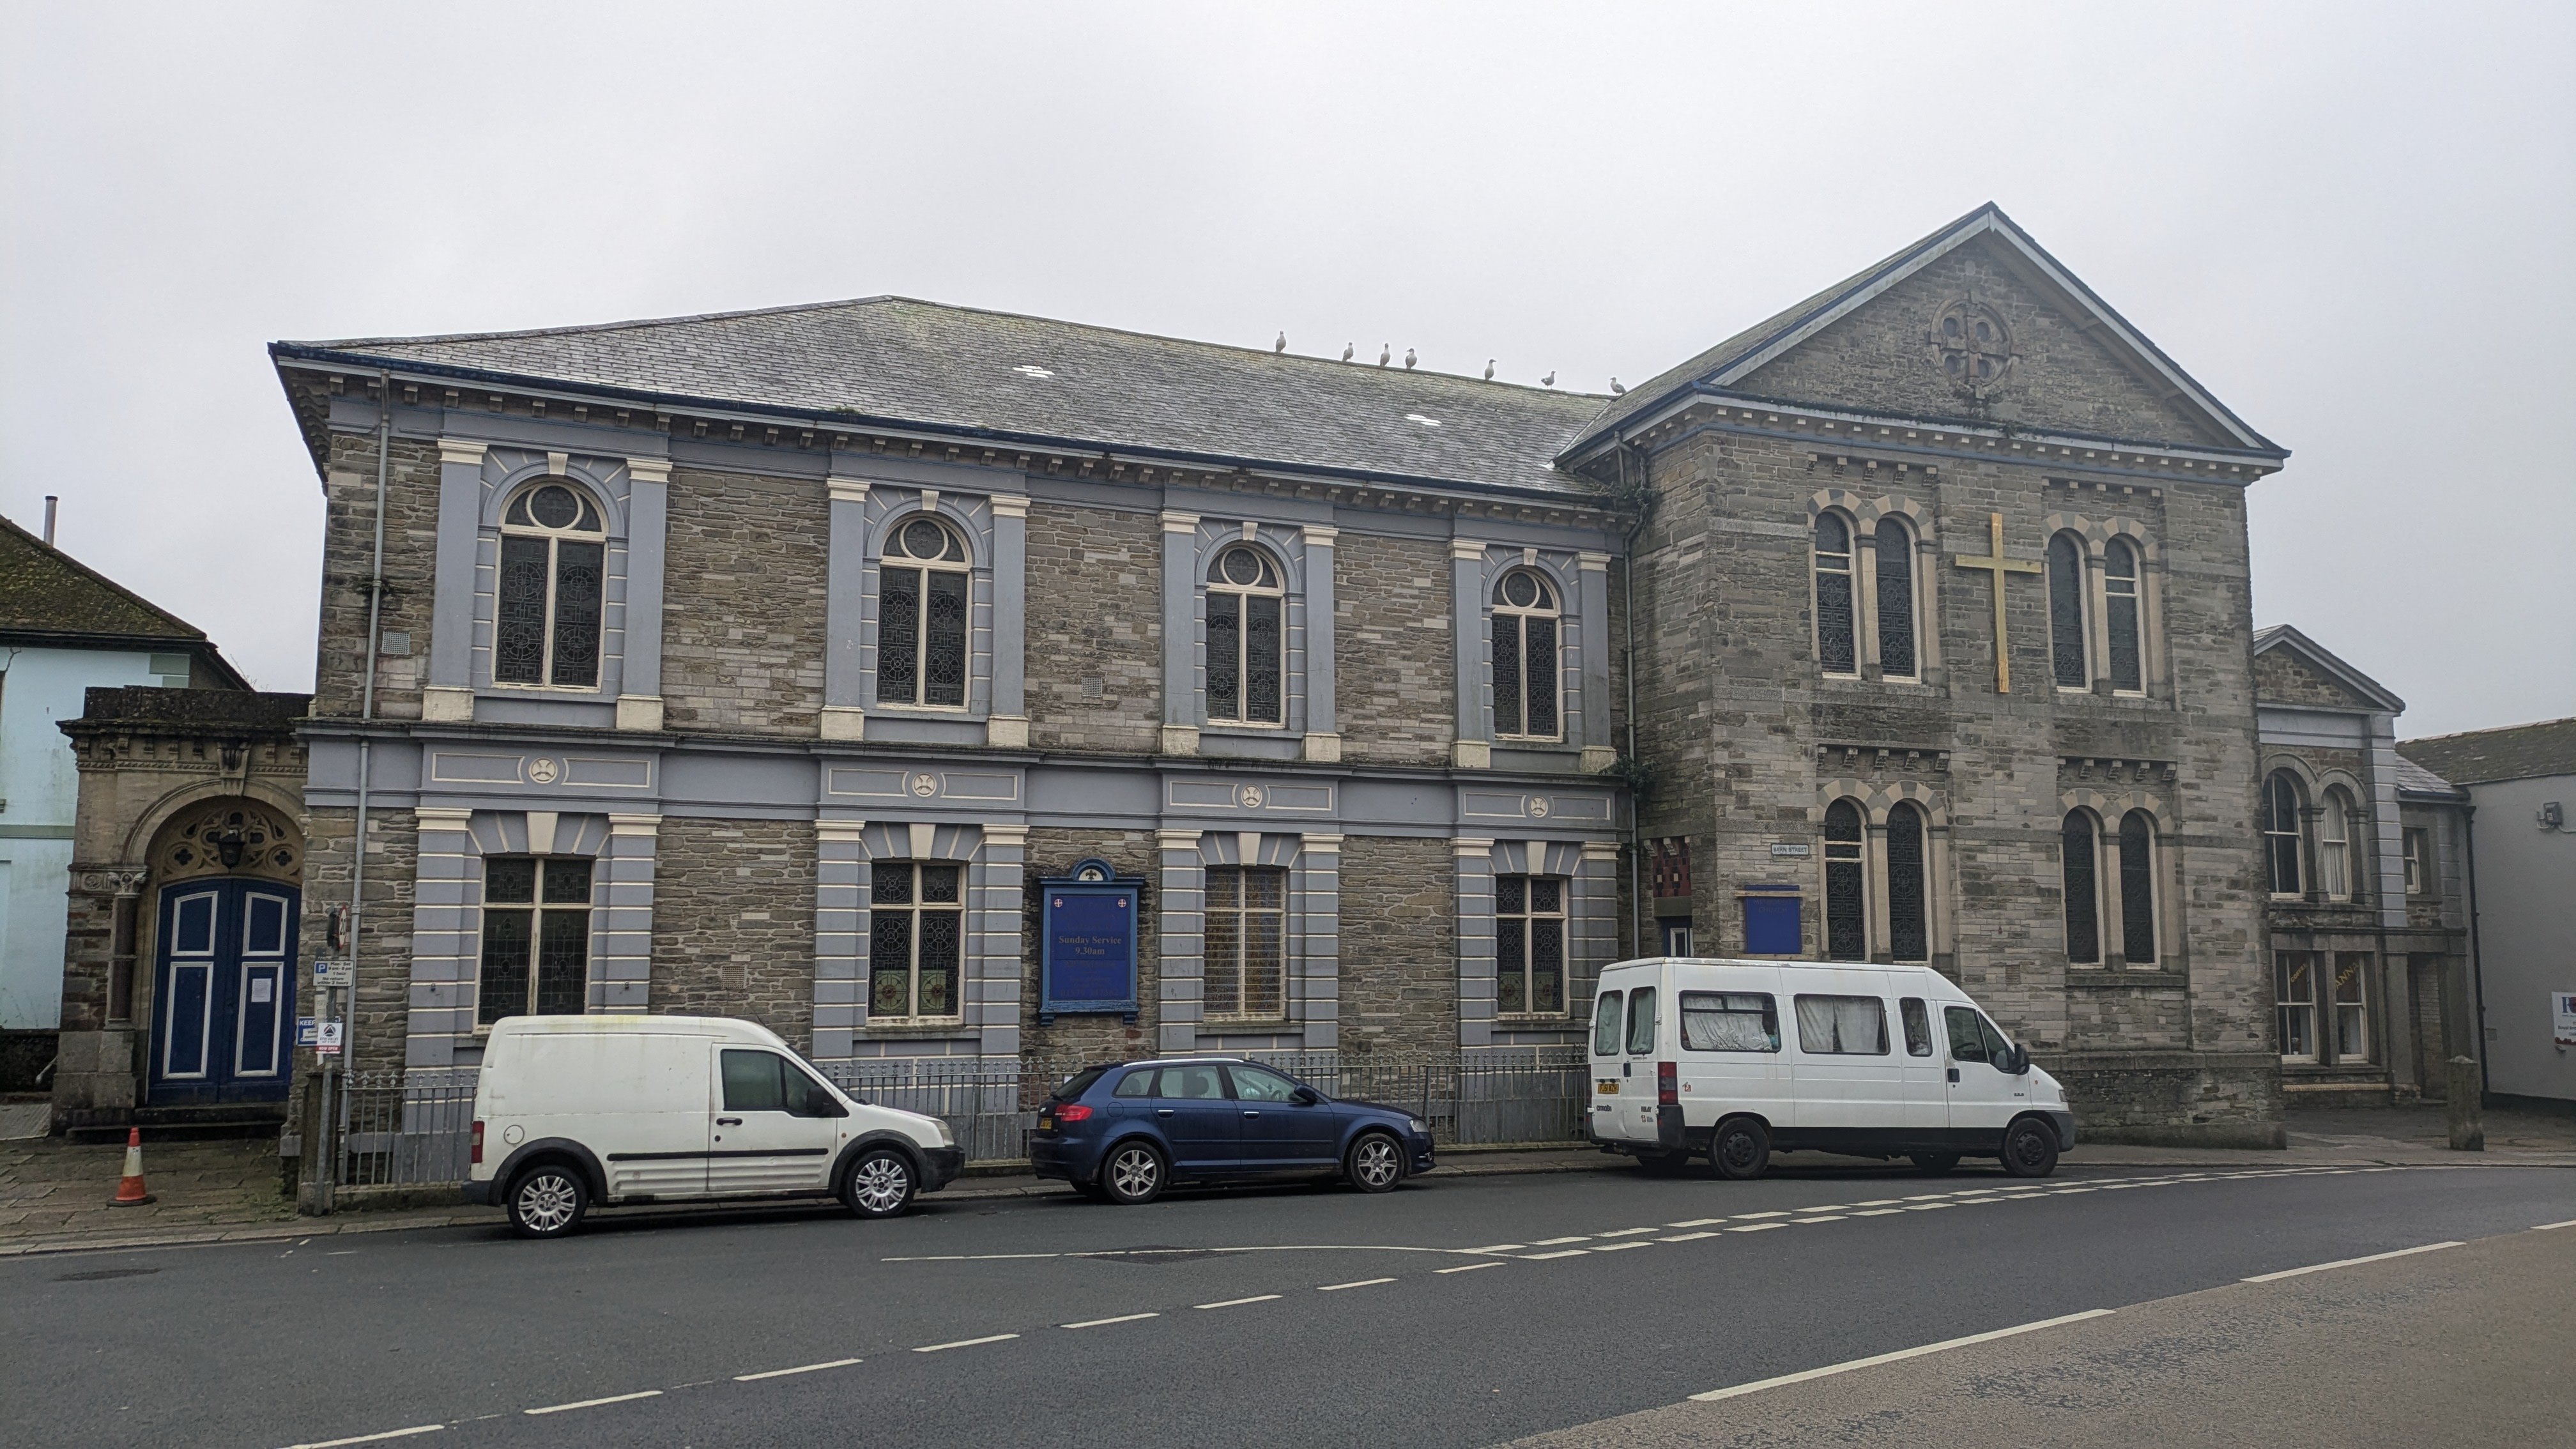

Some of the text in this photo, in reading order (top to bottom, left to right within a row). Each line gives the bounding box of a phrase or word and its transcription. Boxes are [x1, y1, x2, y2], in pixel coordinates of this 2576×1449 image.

[1059, 936, 1122, 945] Sunday Service
[318, 964, 326, 972] P
